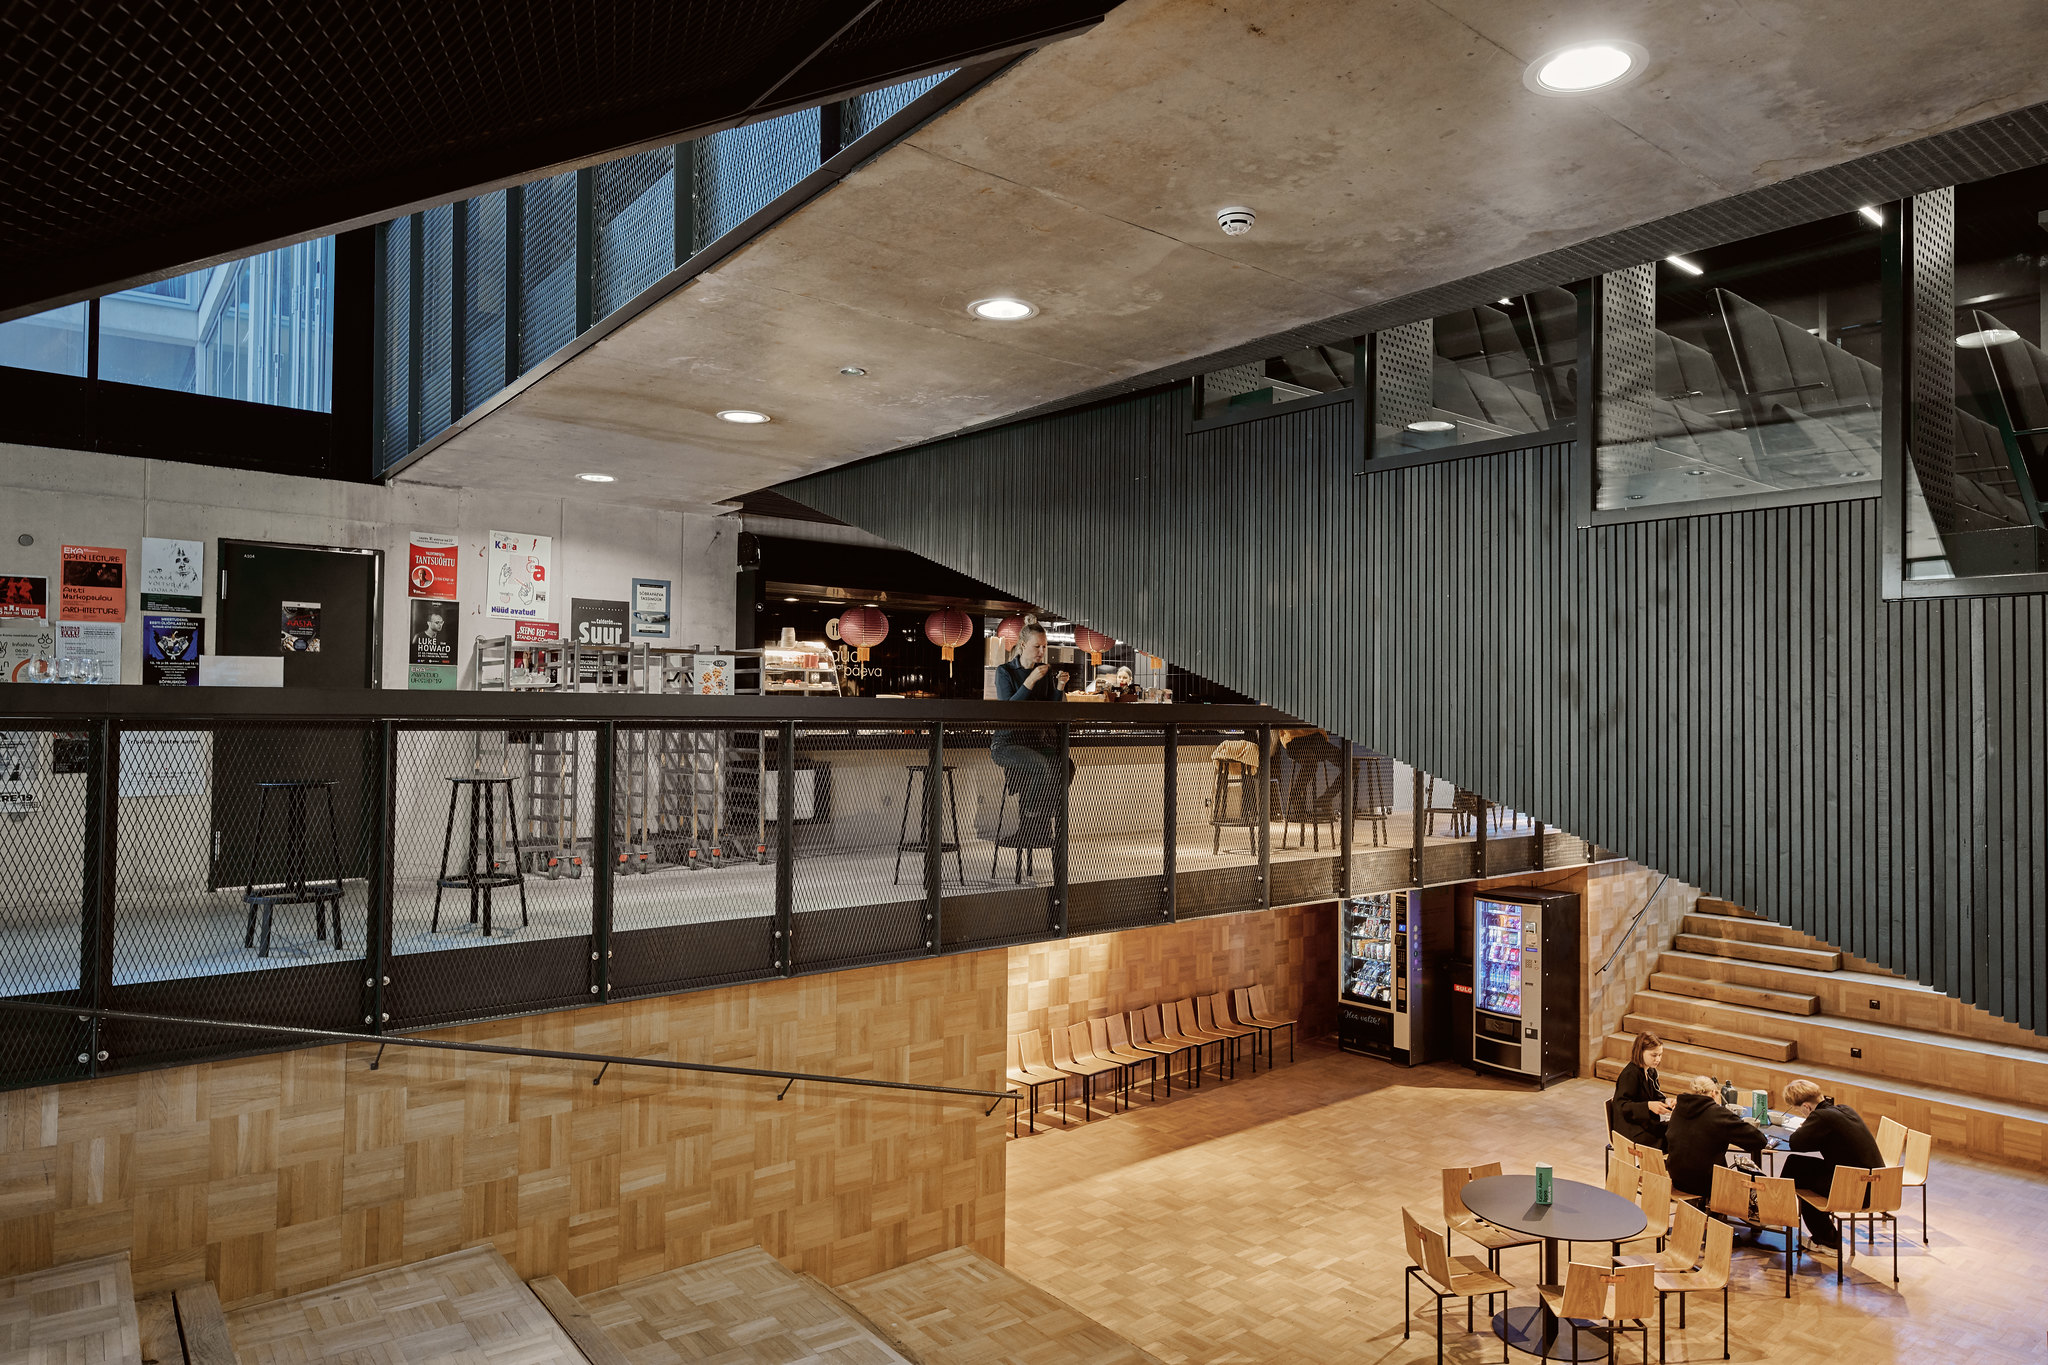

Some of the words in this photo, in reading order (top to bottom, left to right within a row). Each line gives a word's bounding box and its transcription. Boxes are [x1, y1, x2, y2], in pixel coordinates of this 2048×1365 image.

[416, 555, 456, 568] TANTSUÕHTU
[63, 593, 113, 602] Markopoulou
[20, 607, 40, 616] VAULT
[63, 606, 120, 615] ARCHITECTURE
[491, 606, 510, 615] Nüüd
[510, 608, 536, 617] avatud!
[578, 621, 622, 645] Suur
[844, 664, 882, 679] päeva
[1456, 985, 1473, 993] SULO
